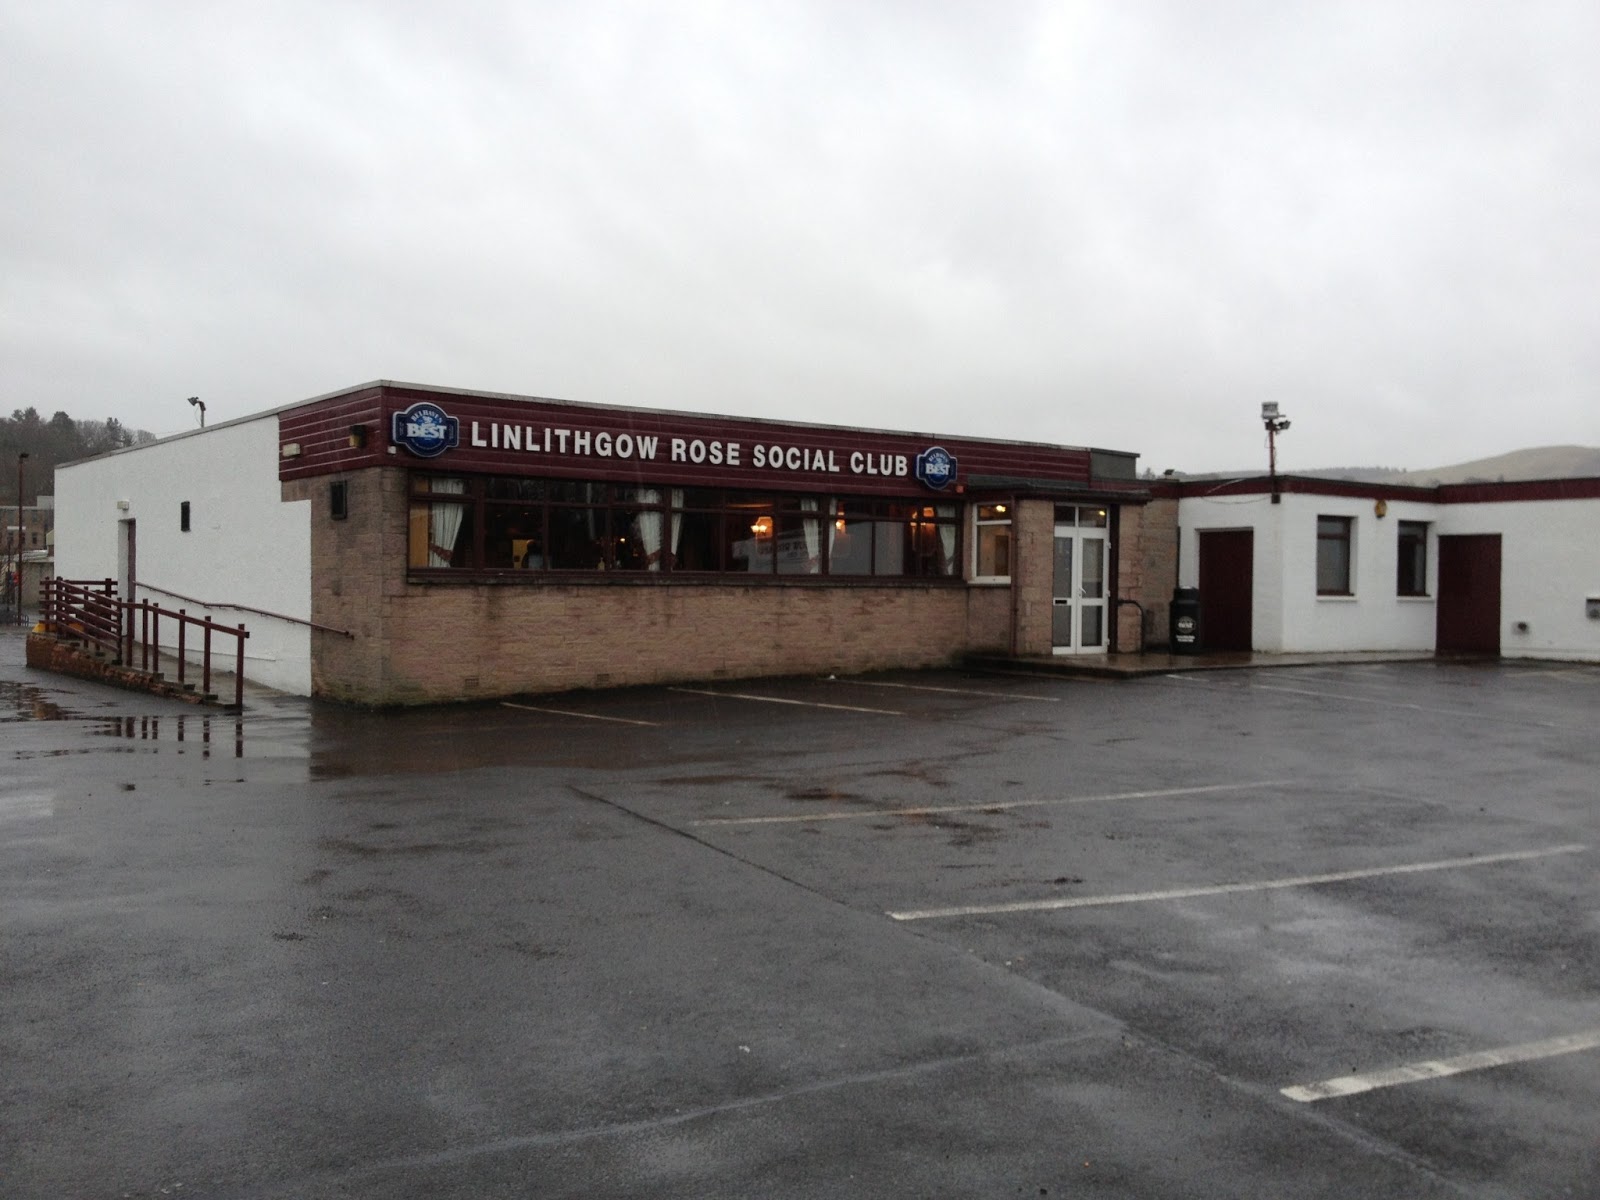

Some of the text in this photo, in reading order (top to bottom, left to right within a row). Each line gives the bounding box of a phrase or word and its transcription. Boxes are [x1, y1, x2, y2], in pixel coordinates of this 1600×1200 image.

[406, 422, 448, 439] BEST
[471, 421, 659, 460] LINLITHGOW
[671, 438, 741, 466] ROSE
[752, 444, 840, 472] SOCIAL
[850, 452, 908, 476] CLUB
[925, 463, 950, 475] BEST
